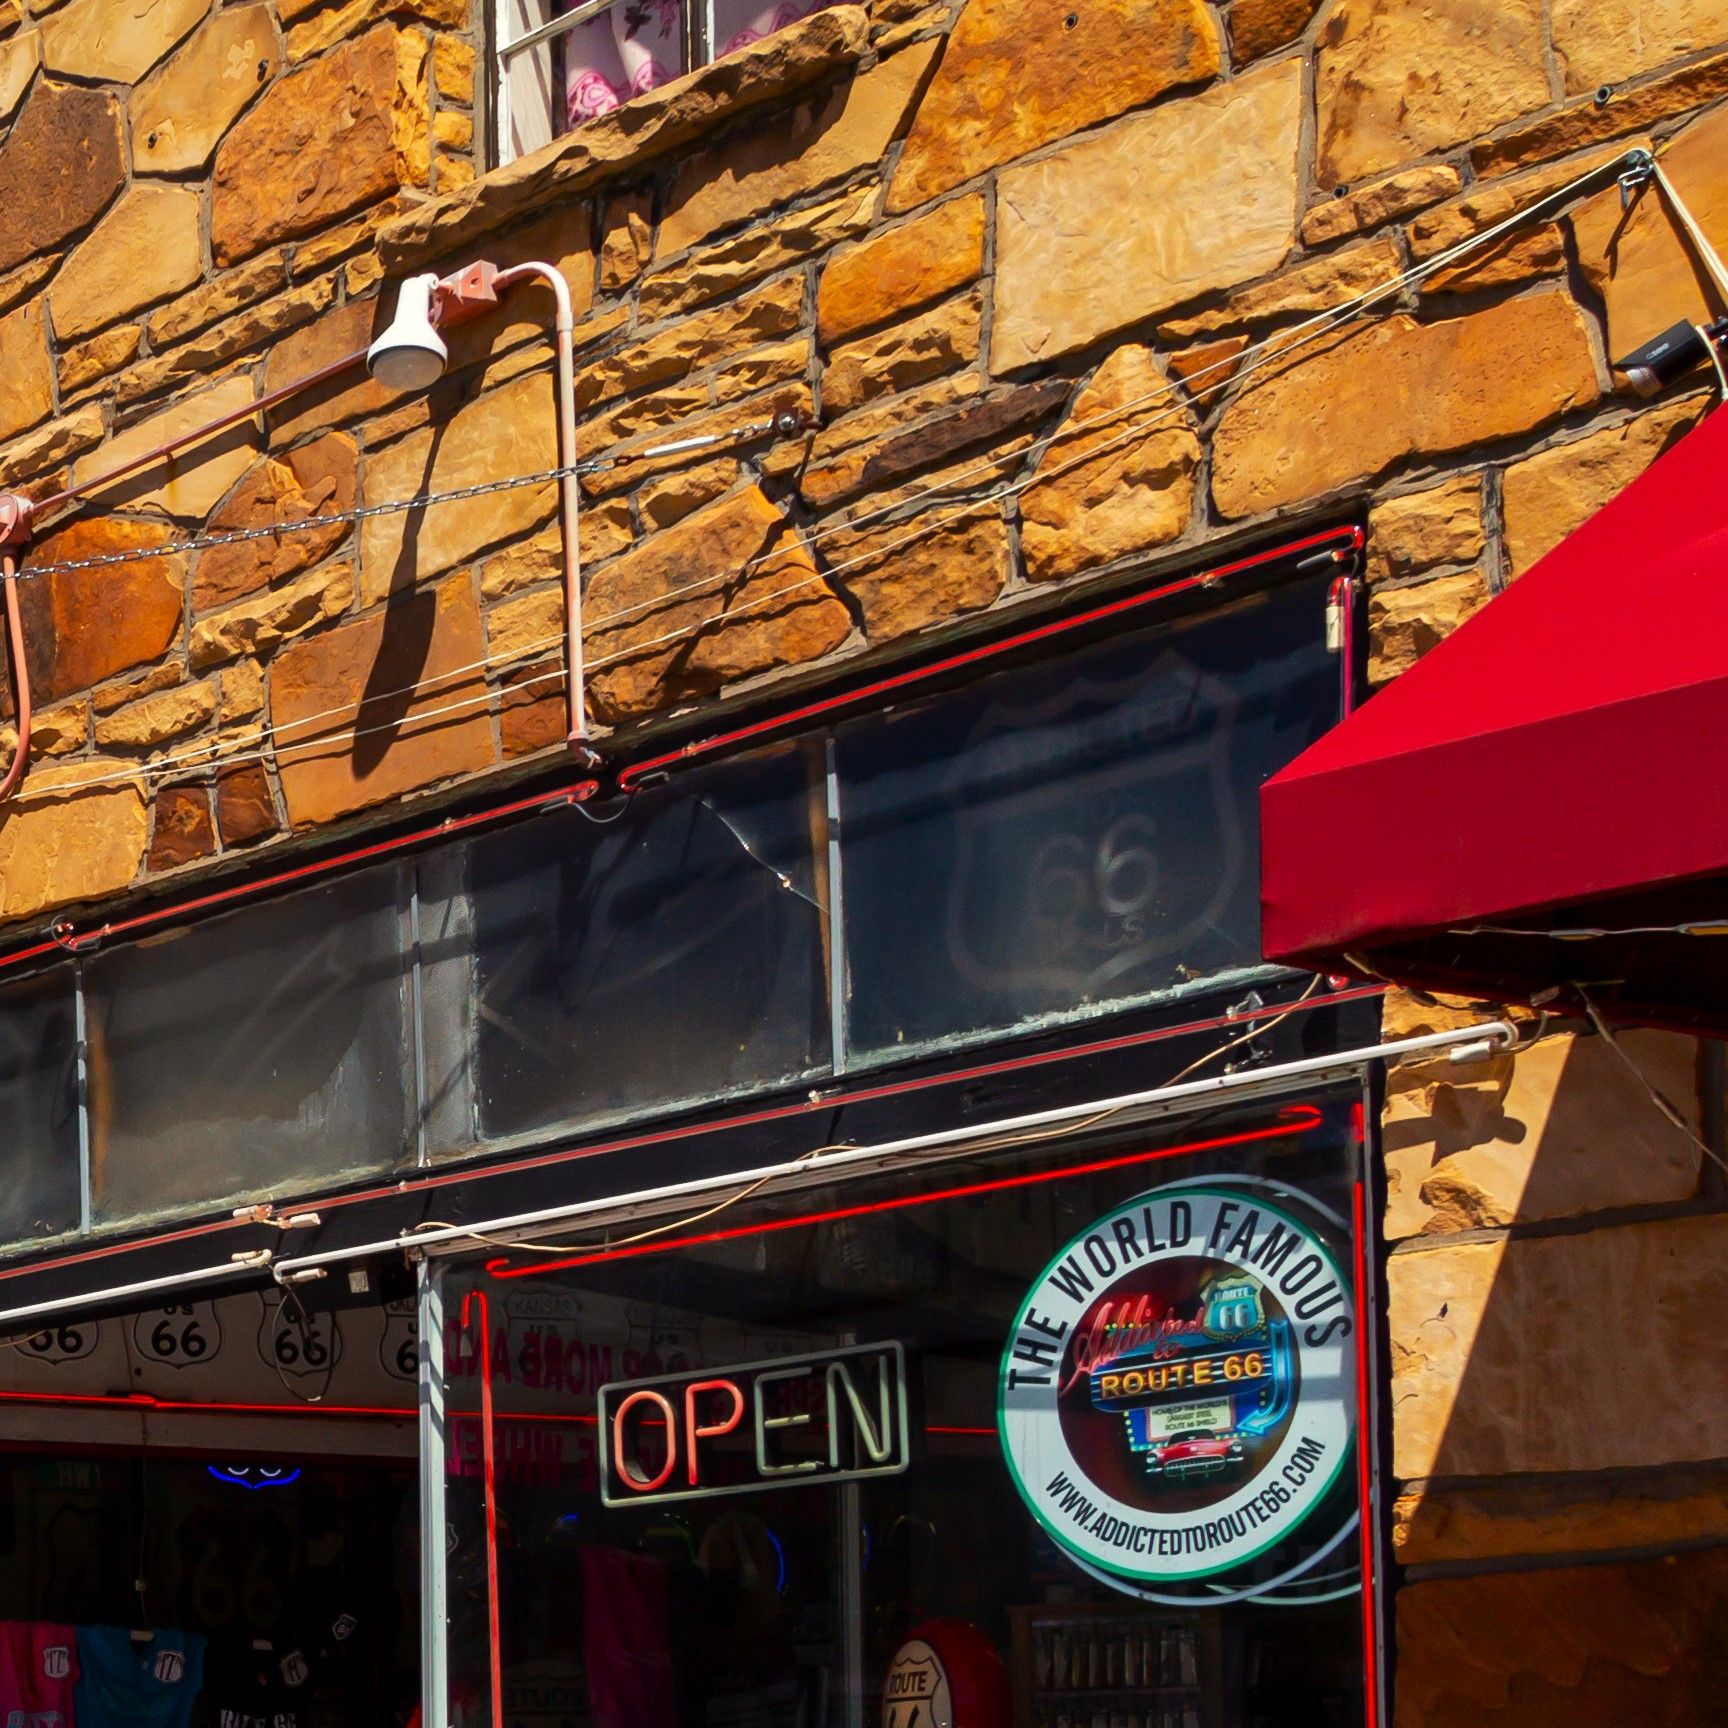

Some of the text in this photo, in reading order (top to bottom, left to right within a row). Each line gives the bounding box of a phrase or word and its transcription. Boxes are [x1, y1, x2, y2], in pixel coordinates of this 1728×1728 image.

[1007, 1199, 1353, 1392] THE WORLD FAMOUS
[1213, 1285, 1251, 1300] ROUTE
[1219, 1302, 1250, 1331] 66
[151, 1320, 206, 1358] 66
[275, 1328, 328, 1367] 66
[1100, 1351, 1264, 1400] ROUTE 66
[612, 1354, 892, 1493] OPEN
[1044, 1436, 1327, 1557] WWW.ADDICTEDTOROUTE66.COM
[890, 1670, 929, 1696] ROUTE
